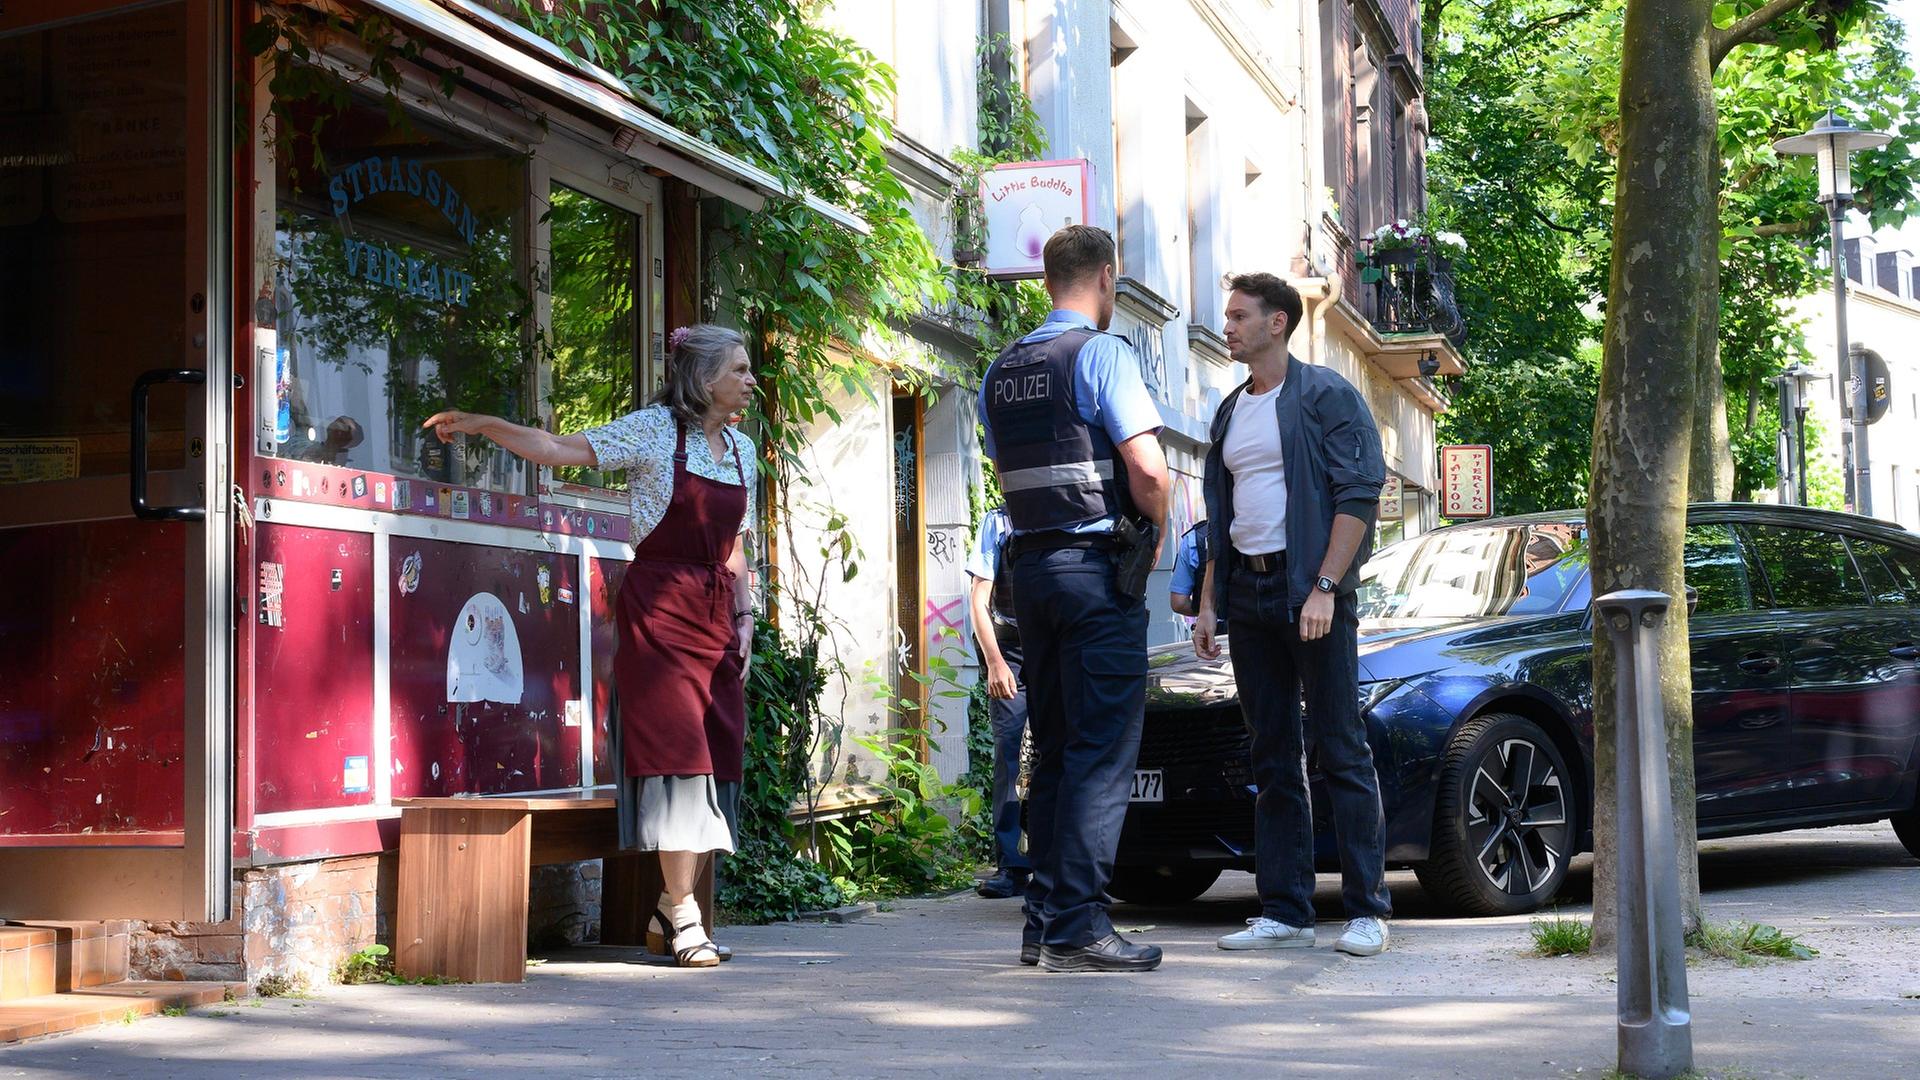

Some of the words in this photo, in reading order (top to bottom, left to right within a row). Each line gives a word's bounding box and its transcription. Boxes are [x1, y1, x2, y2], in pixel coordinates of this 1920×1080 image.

[330, 155, 479, 246] STRASSEN
[992, 180, 1027, 202] Little
[1030, 176, 1073, 197] Buddha
[344, 238, 473, 307] VERKAUF
[994, 373, 1050, 405] POLIZEI
[1450, 454, 1461, 510] TATTOO
[1472, 454, 1483, 510] PIERCING
[1131, 773, 1161, 798] 177
